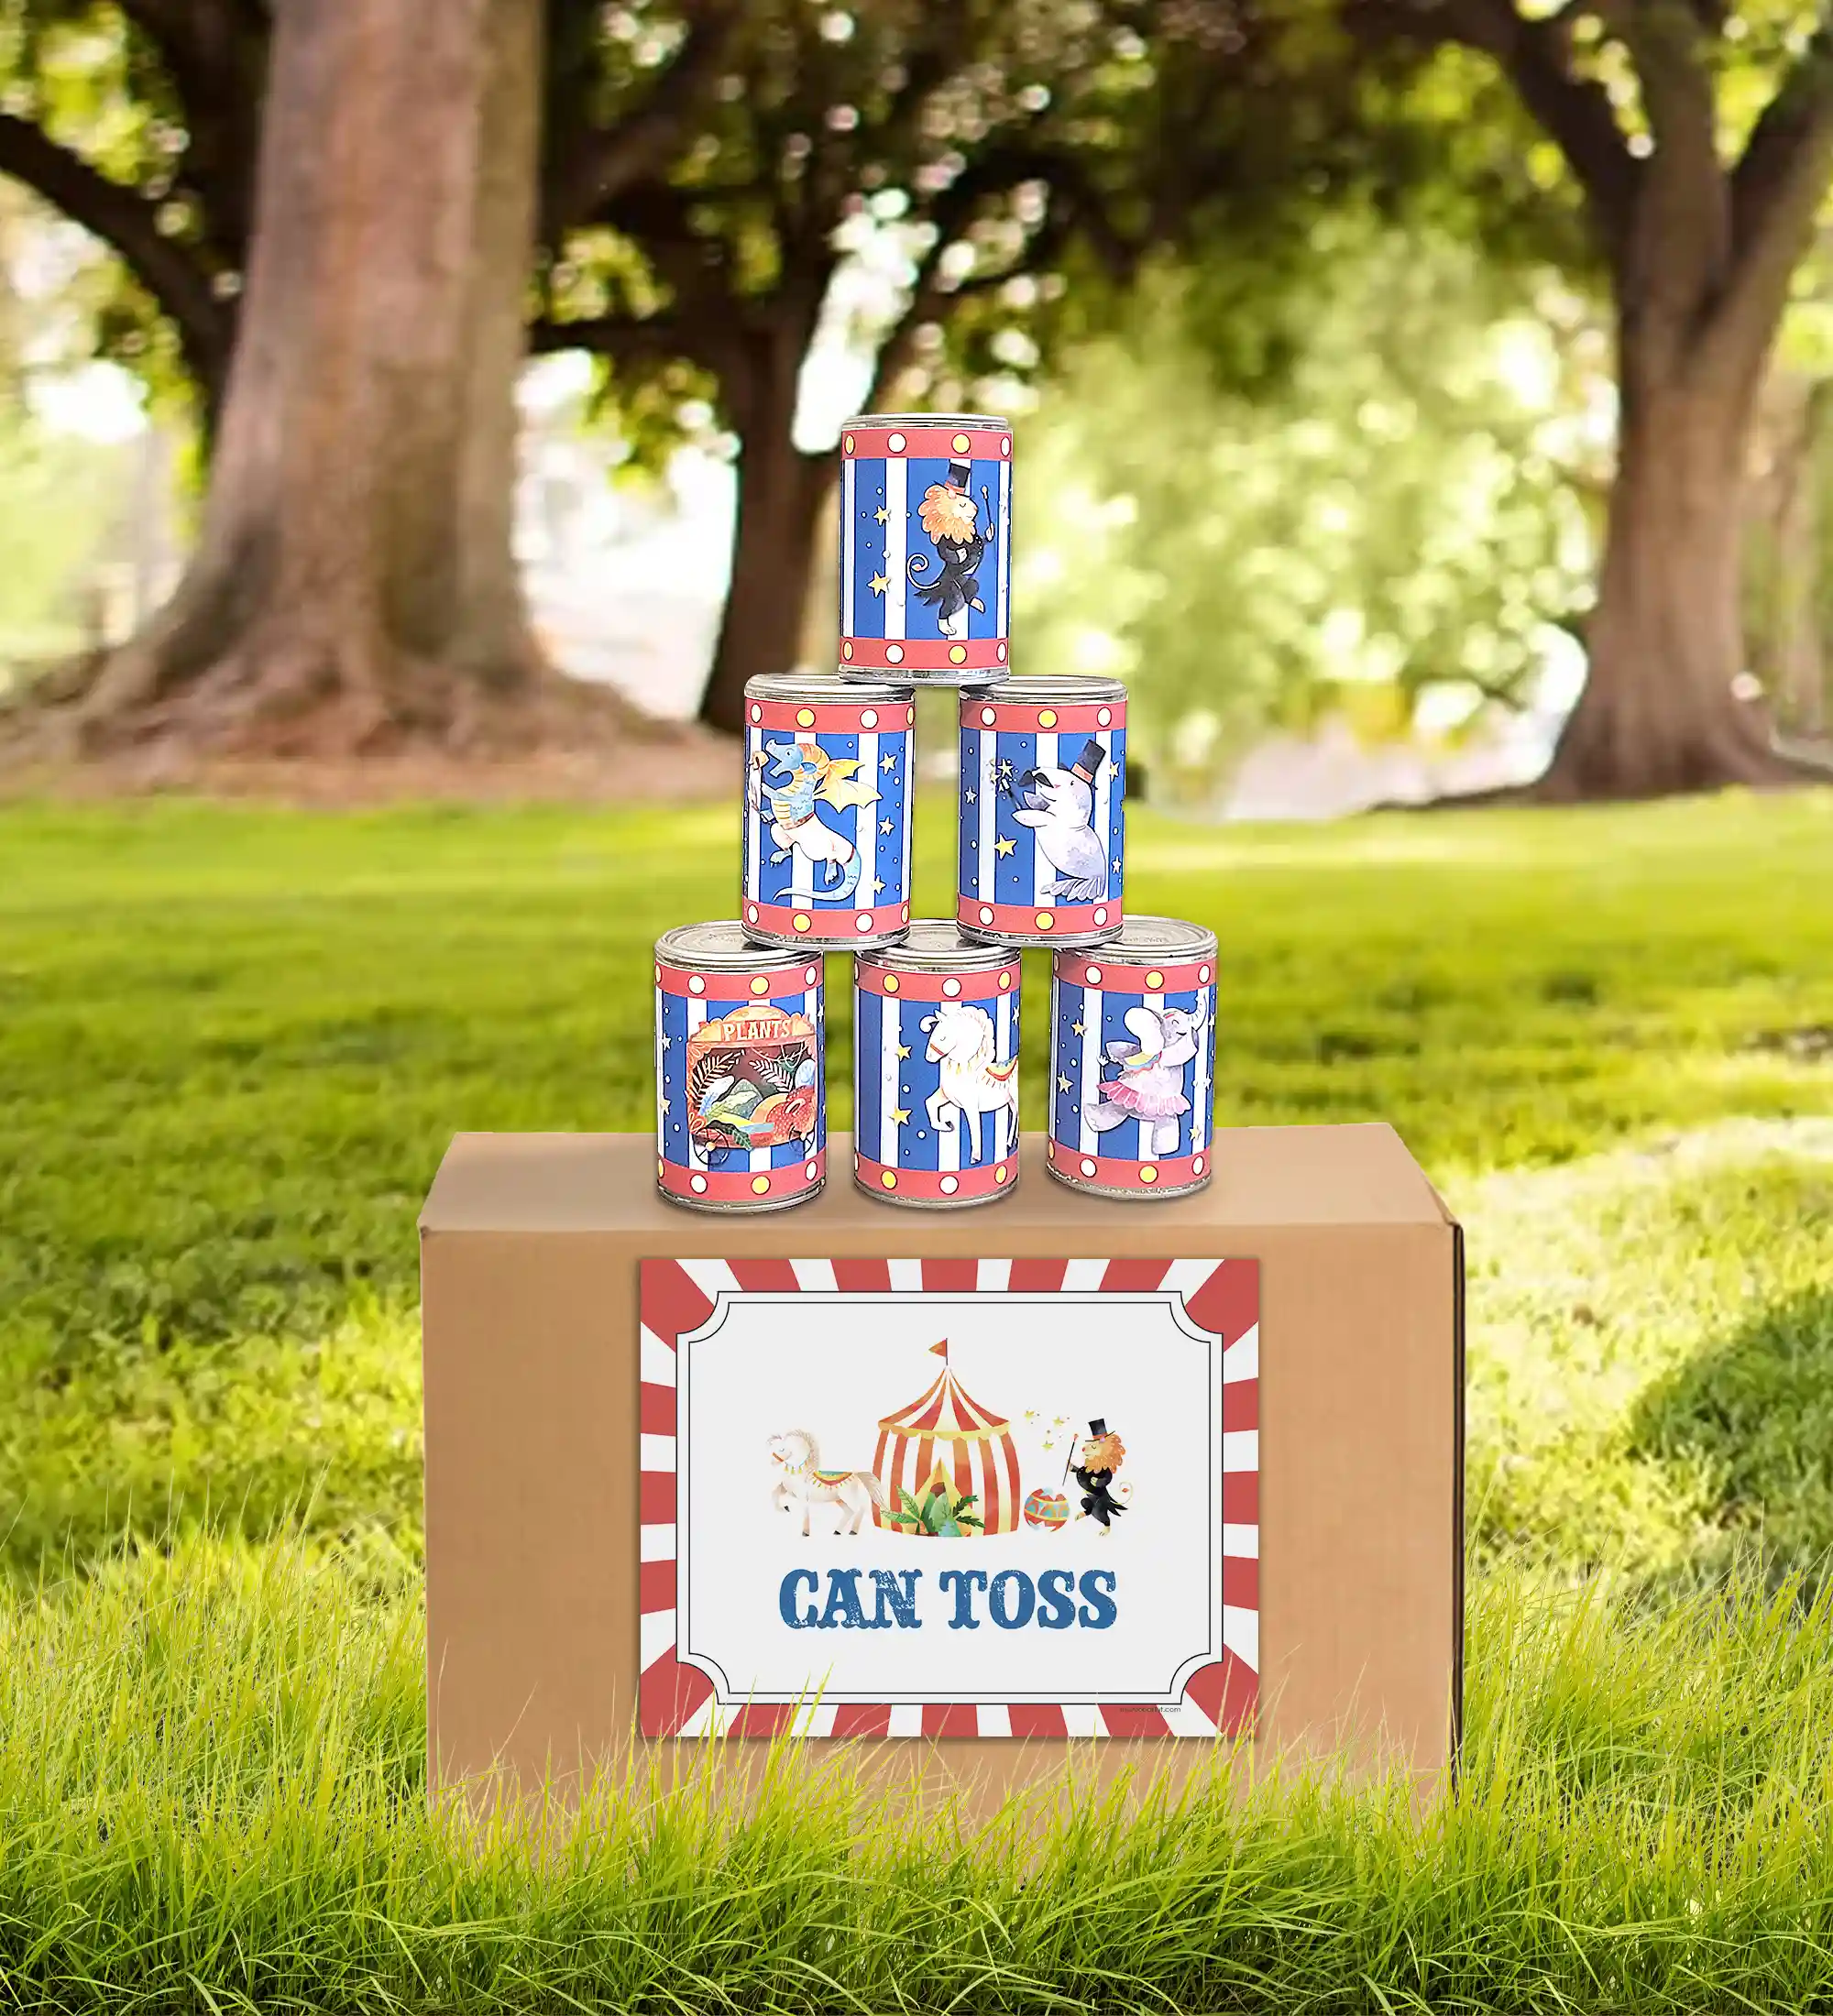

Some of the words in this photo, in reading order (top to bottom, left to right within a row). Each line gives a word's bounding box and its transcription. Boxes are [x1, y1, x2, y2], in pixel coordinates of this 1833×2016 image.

[722, 1019, 789, 1042] PLANTS
[779, 1568, 923, 1629] CAN
[938, 1569, 1117, 1629] TOSS
